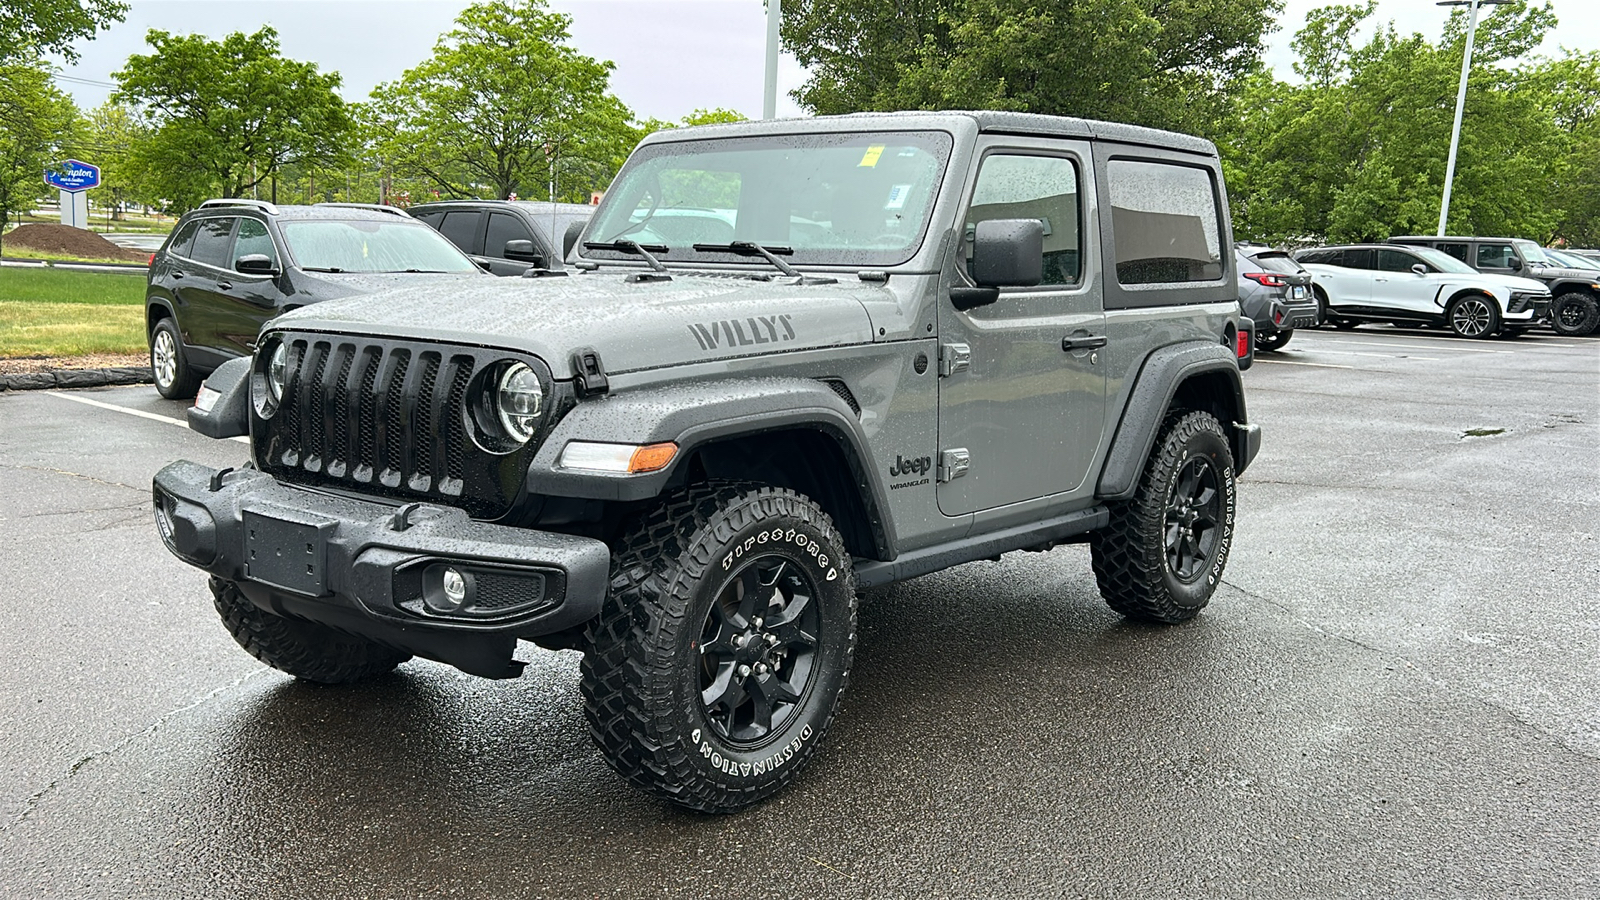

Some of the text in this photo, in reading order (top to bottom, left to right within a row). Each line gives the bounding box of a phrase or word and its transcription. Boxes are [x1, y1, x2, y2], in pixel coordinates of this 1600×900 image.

[687, 314, 796, 351] WILLYS
[890, 454, 932, 477] Jeep
[890, 478, 930, 490] WRANGLER
[721, 527, 829, 572] Firestone
[699, 723, 814, 778] DESTINATION
